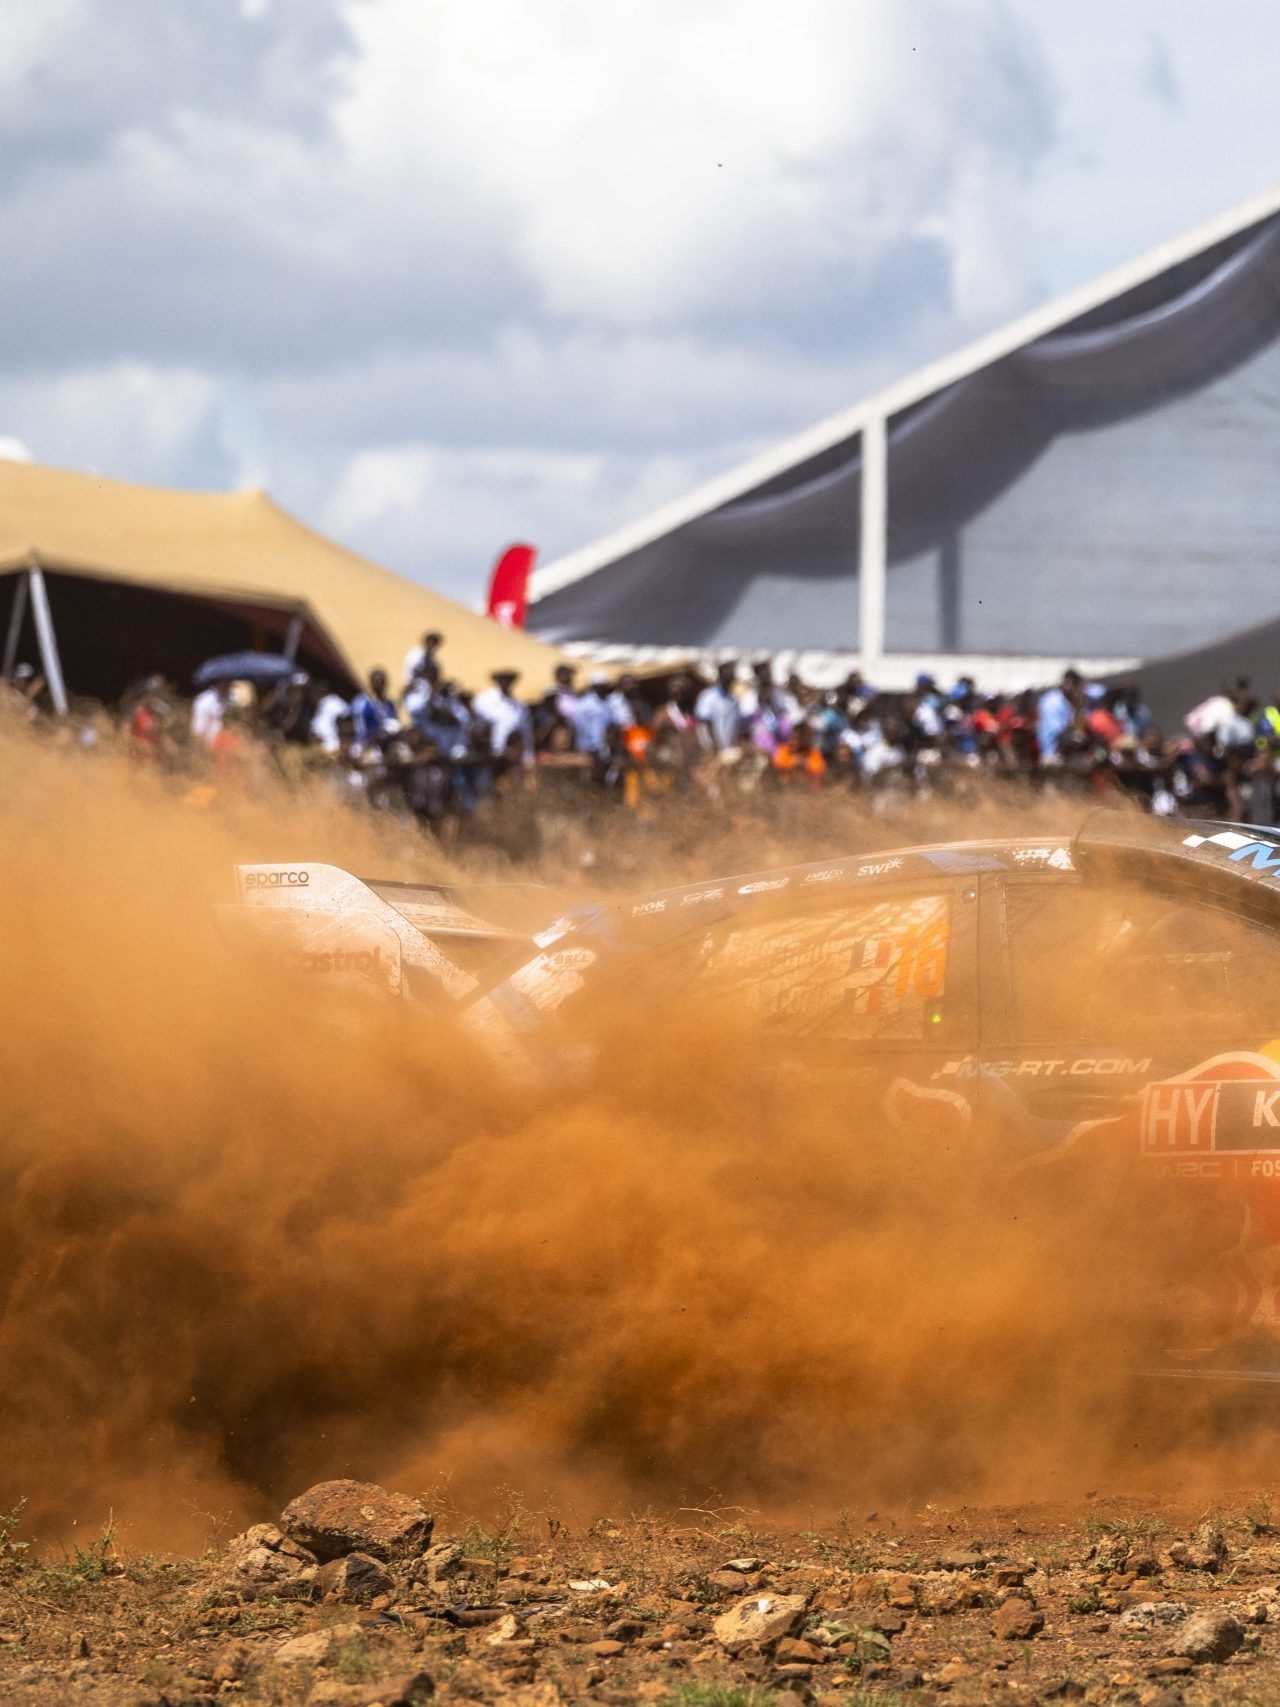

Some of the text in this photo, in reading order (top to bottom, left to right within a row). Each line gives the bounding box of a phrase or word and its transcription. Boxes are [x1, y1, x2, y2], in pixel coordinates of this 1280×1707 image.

[245, 871, 309, 888] sparco
[296, 945, 382, 974] astrol
[1150, 1089, 1214, 1145] HY
